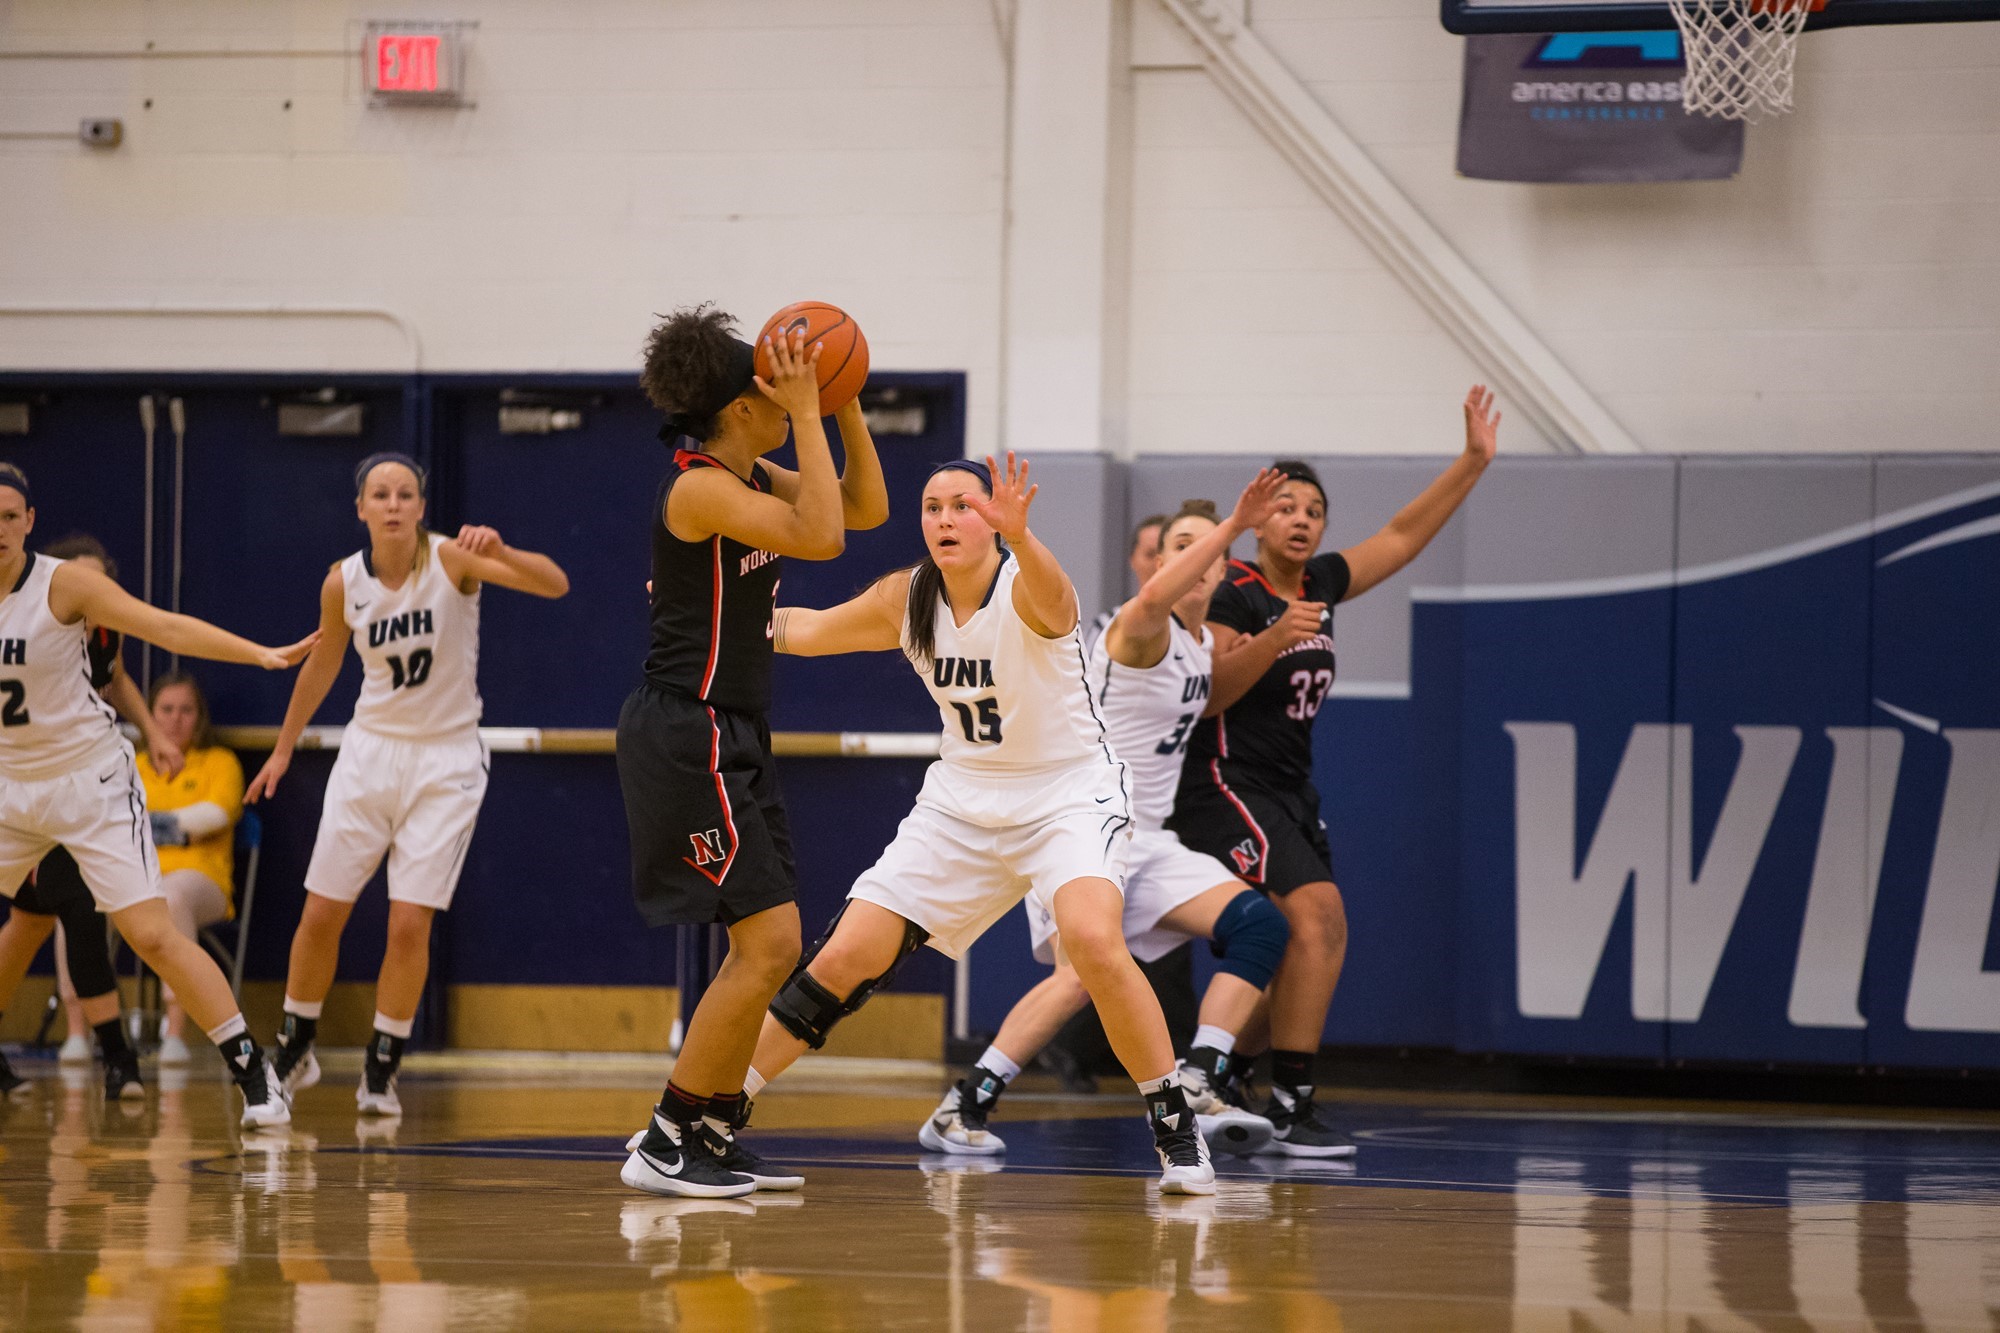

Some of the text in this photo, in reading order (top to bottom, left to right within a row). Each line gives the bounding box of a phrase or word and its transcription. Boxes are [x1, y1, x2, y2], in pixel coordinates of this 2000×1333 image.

[1511, 80, 1623, 102] america
[369, 609, 433, 648] UNH
[386, 647, 434, 690] 10
[1286, 668, 1333, 721] 33
[948, 696, 1003, 746] 15
[689, 828, 726, 866] N
